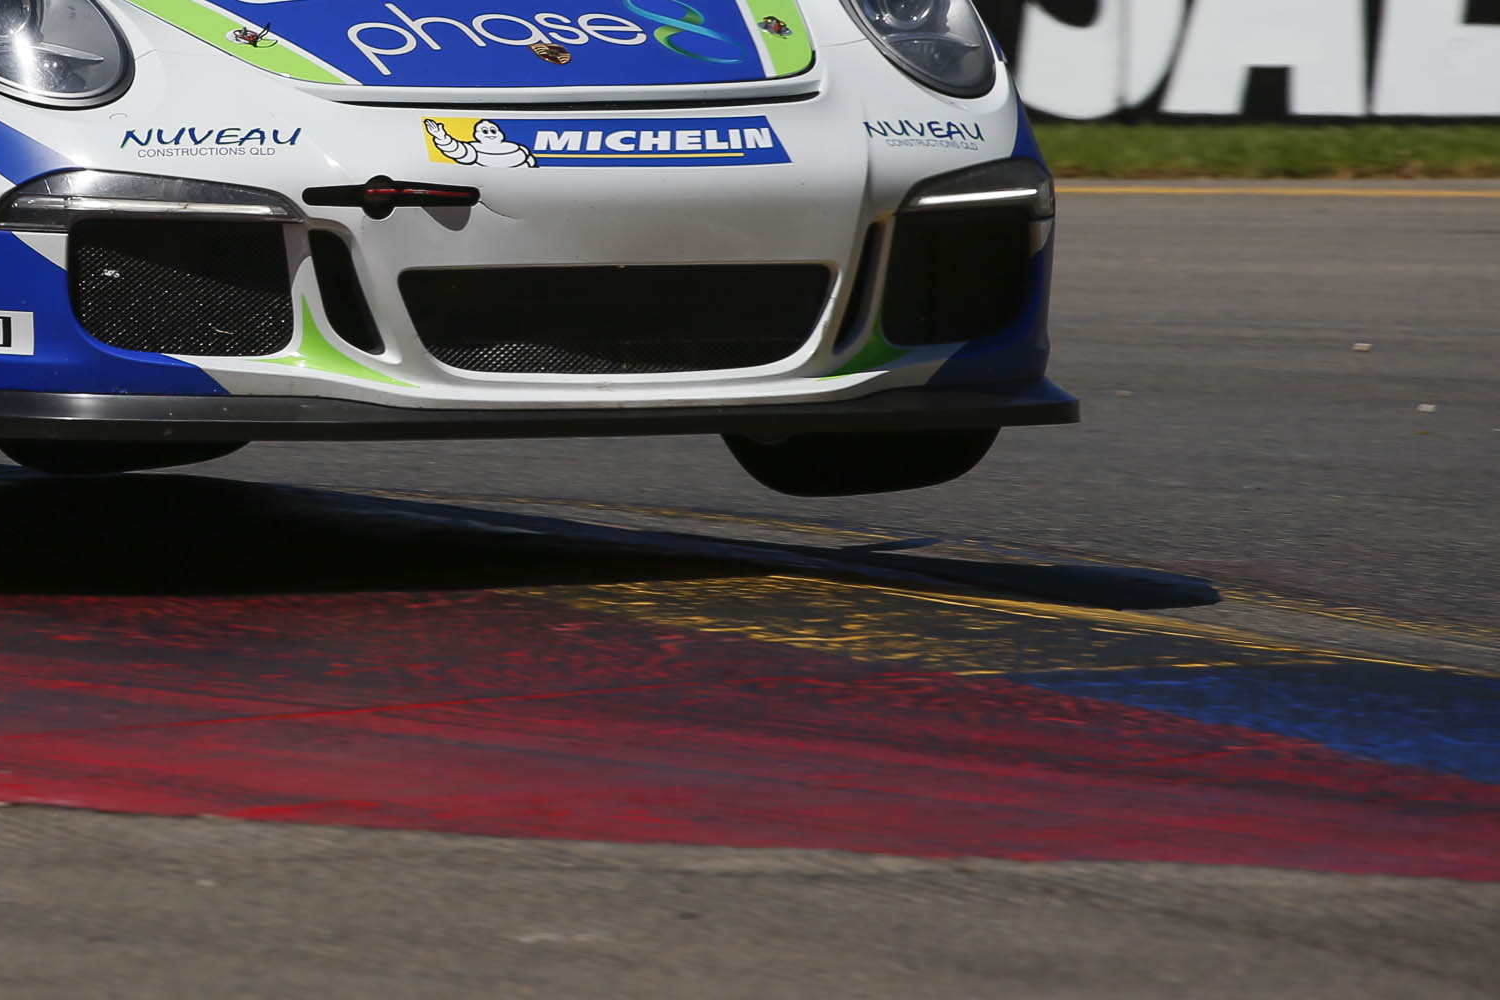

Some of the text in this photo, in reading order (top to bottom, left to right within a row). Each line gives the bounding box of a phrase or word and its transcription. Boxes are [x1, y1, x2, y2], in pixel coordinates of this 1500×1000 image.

[120, 127, 302, 149] NUVEAU
[534, 127, 774, 152] MICHELIN
[863, 119, 985, 141] NUVEAU
[137, 146, 276, 158] CONSTRUCTIONS QLD
